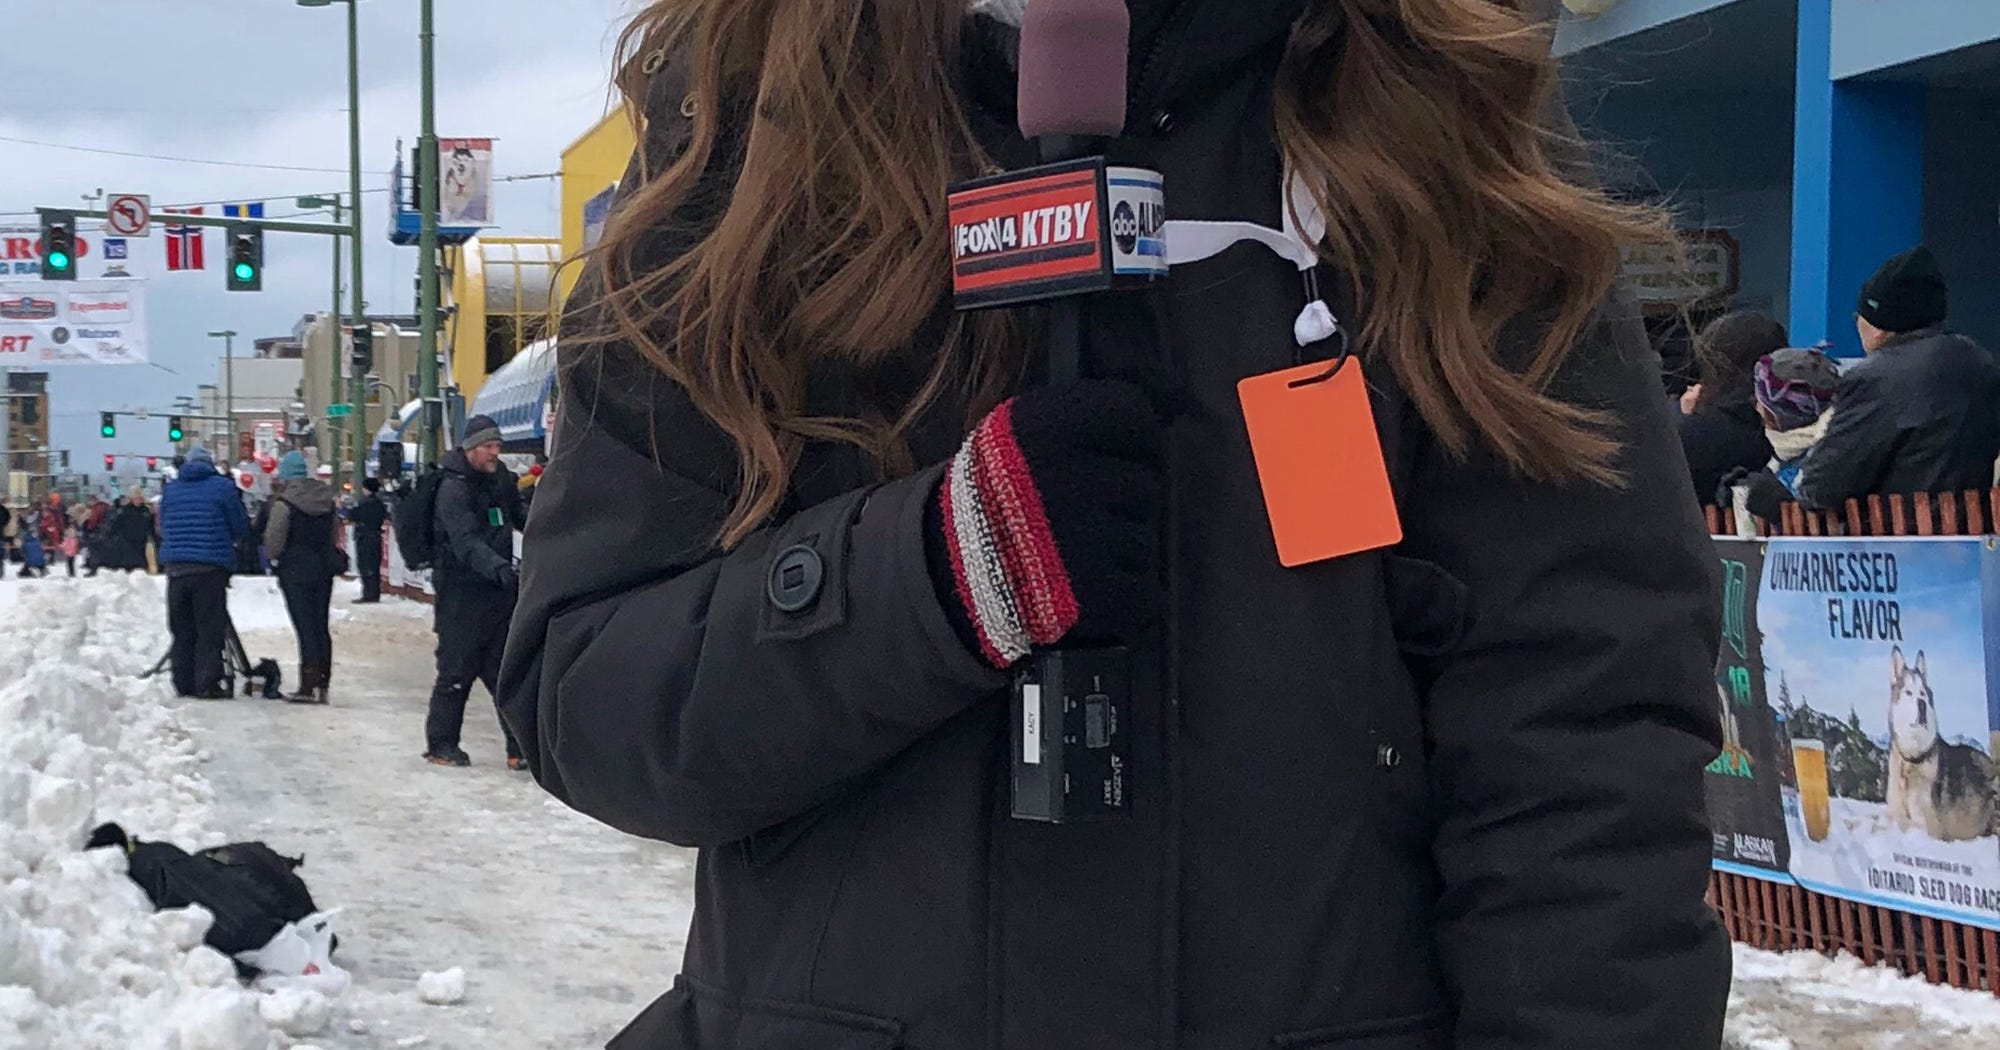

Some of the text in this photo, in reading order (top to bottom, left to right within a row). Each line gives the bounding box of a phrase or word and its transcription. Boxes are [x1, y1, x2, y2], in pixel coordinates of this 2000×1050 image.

[954, 200, 1092, 258] FOX 4 KTBY
[1113, 212, 1137, 236] abc
[1770, 551, 1898, 593] UNHARNESSED
[1828, 600, 1903, 641] FLAVOR
[1112, 767, 1122, 807] AZDEN
[1867, 867, 1915, 896] IDITAROD
[1918, 875, 1946, 902] SLED
[1948, 881, 1972, 907] DOG
